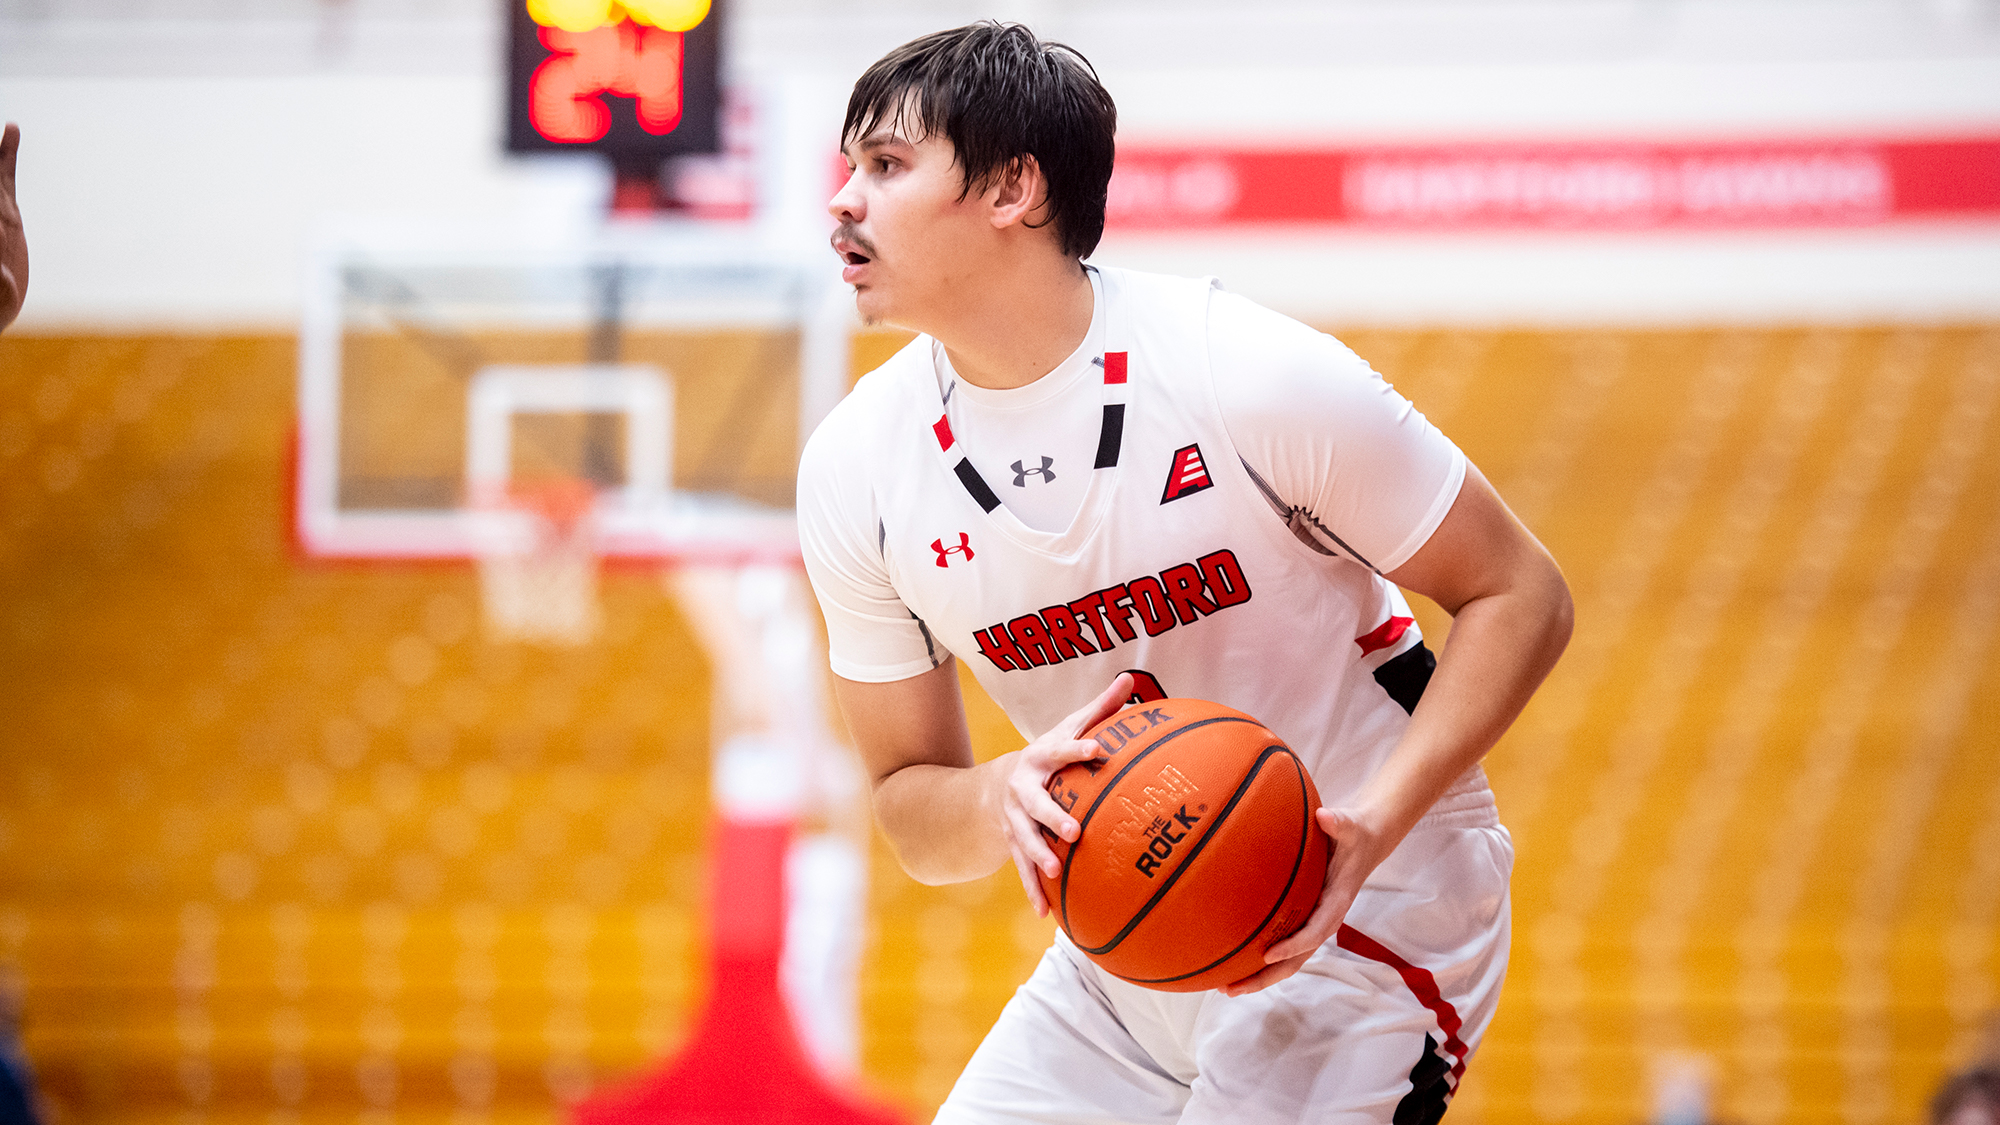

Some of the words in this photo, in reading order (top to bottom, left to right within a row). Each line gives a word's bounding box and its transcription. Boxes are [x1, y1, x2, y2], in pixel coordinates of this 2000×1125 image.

[972, 548, 1252, 673] HARTFORD
[1135, 803, 1202, 879] ROCK
[1142, 815, 1166, 839] THE
